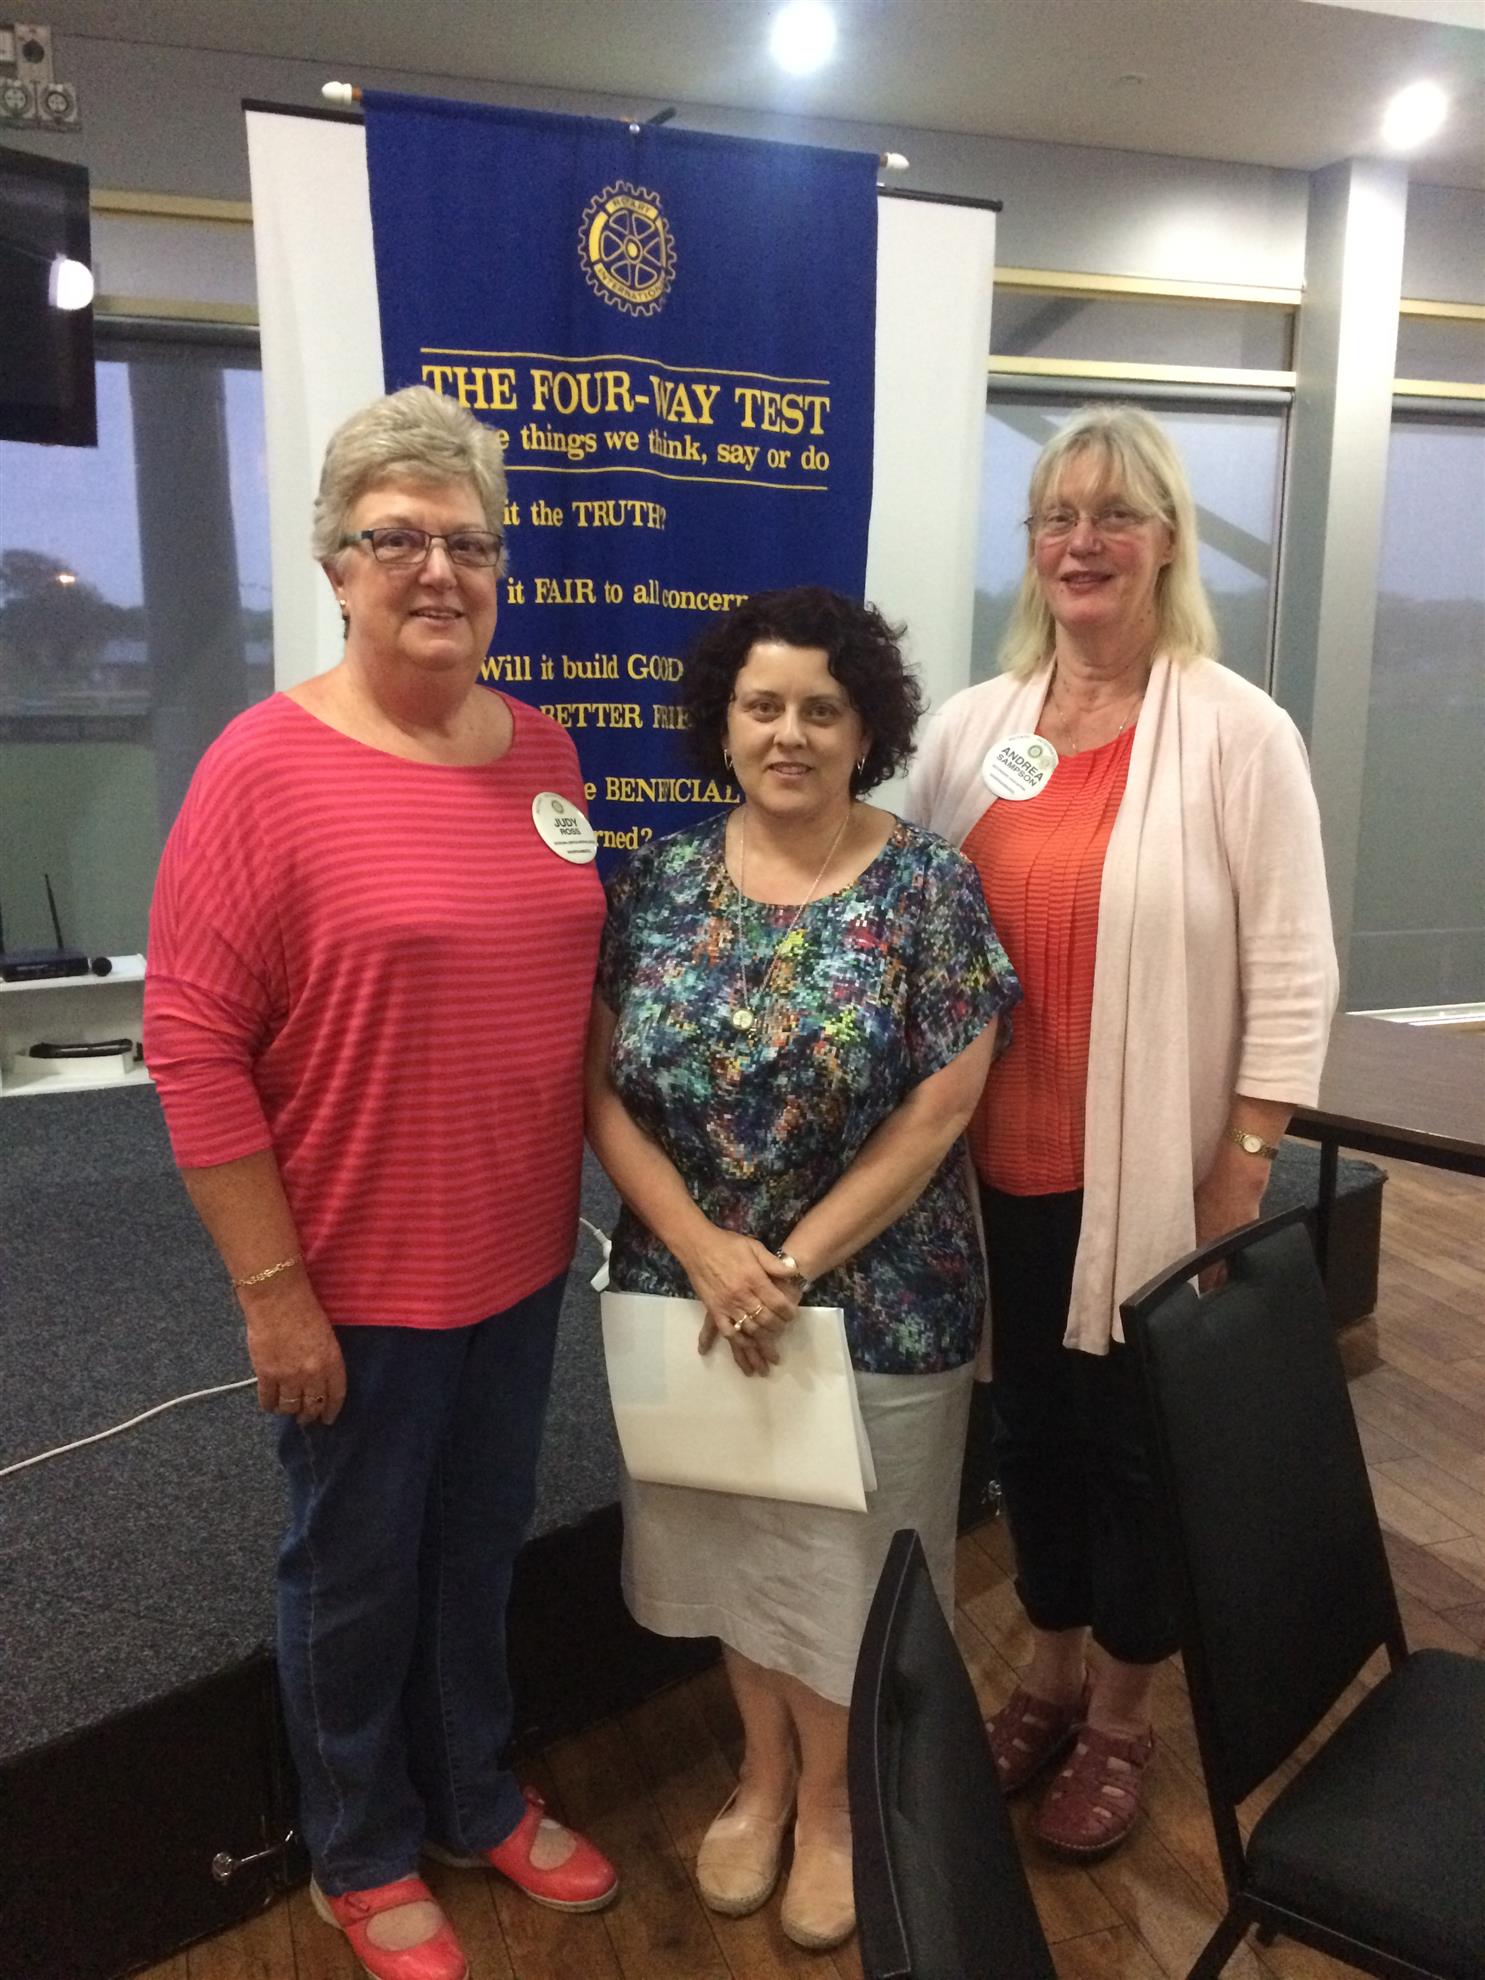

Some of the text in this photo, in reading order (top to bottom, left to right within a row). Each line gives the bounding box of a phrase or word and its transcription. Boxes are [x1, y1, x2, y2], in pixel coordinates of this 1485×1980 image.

[421, 365, 830, 435] THE FOUR-WAY TEST
[520, 423, 597, 460] things
[604, 430, 639, 451] we
[648, 429, 707, 465] think,
[717, 442, 760, 471] say
[767, 448, 791, 469] or
[801, 445, 830, 471] do
[503, 500, 667, 531] it the TRUTH?
[507, 577, 525, 605] it
[534, 578, 597, 604] FAIR
[604, 580, 623, 604] to
[633, 579, 660, 605] all
[480, 654, 533, 681] Will
[540, 654, 554, 681] it
[562, 653, 619, 680] build
[540, 703, 691, 730] BETTER FRIE
[996, 753, 1037, 787] SAMPSON
[1001, 747, 1044, 782] ANDREA
[583, 783, 597, 800] e
[553, 817, 578, 828] JUDY
[560, 828, 582, 836] ROSS
[594, 826, 653, 850] rned?
